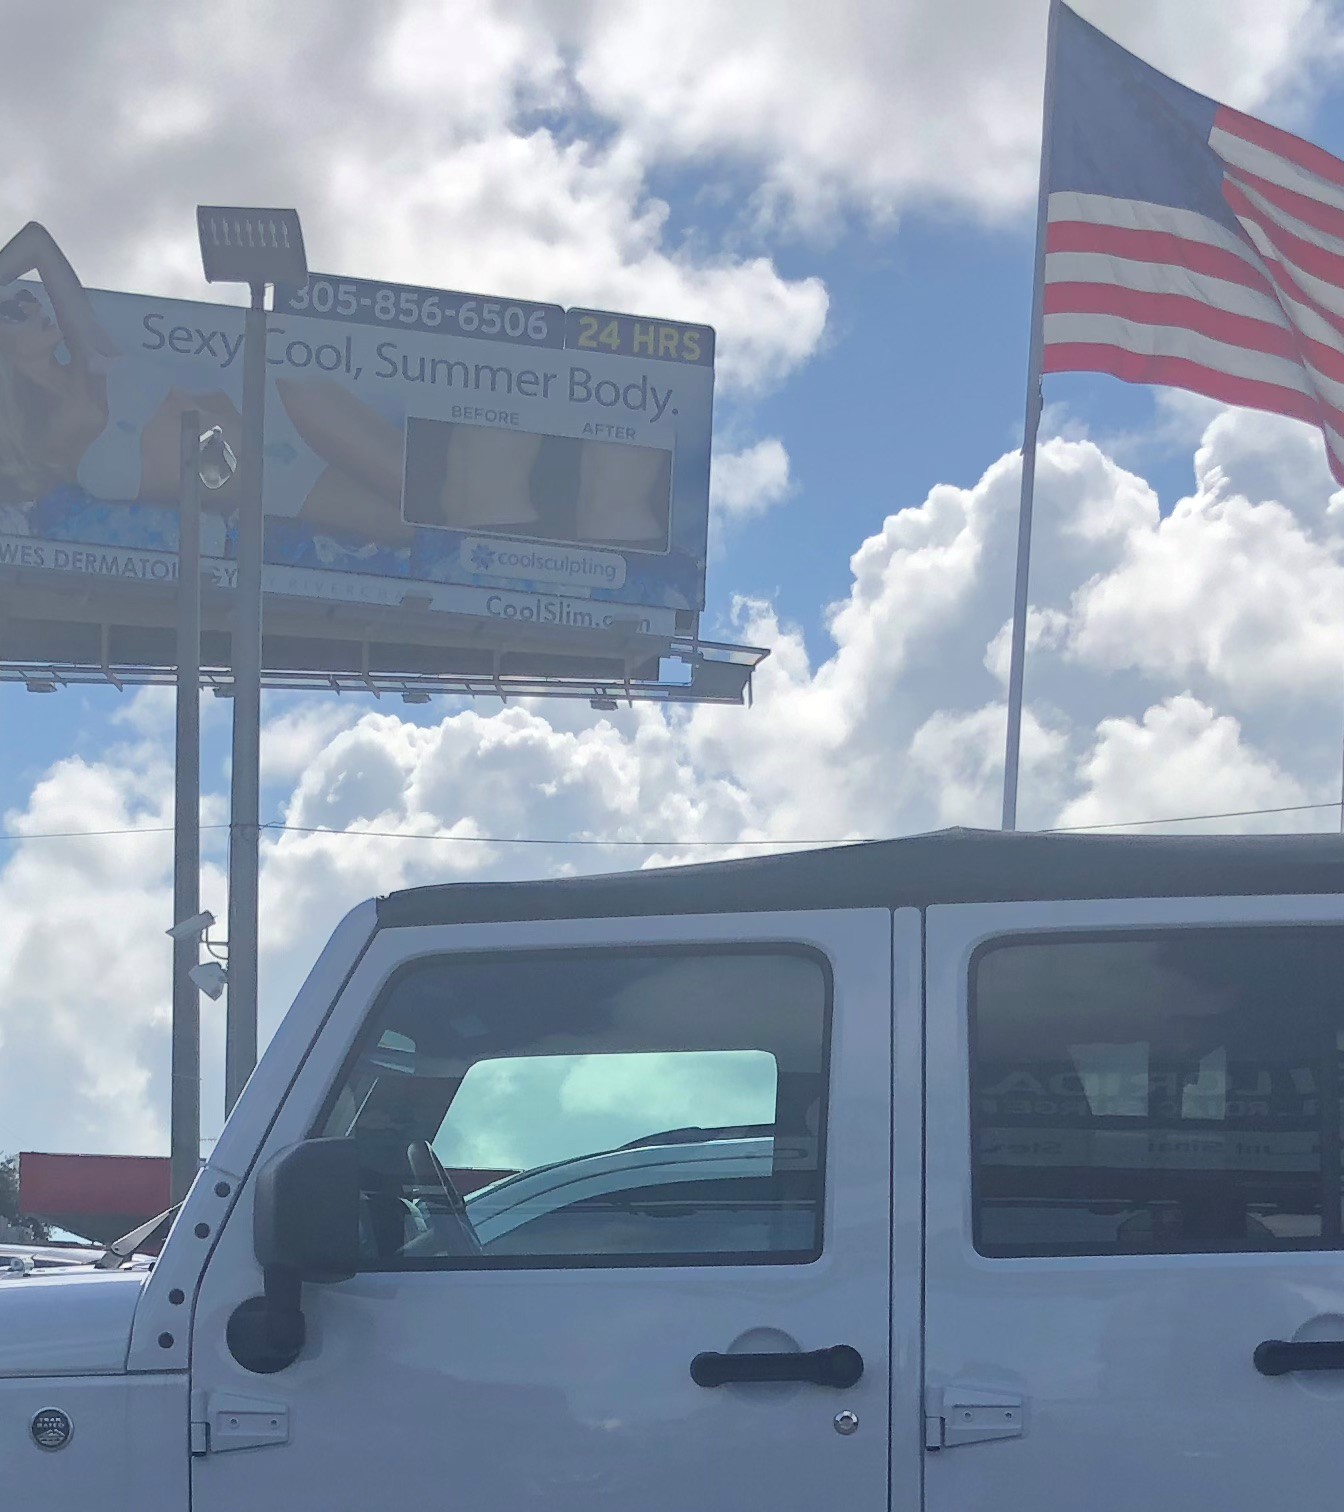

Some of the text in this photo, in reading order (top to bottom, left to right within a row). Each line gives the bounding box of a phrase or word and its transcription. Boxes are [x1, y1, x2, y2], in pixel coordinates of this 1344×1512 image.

[289, 281, 548, 340] 305-856-6506
[577, 315, 702, 361] 24 HRS
[141, 313, 244, 369] Sexy
[375, 341, 557, 399] Summer
[568, 366, 679, 423] Body.
[451, 404, 520, 426] BEFORE
[581, 421, 636, 440] AFTER
[497, 550, 617, 582] coolsculpting
[485, 595, 651, 634] CoolSlim.cm
